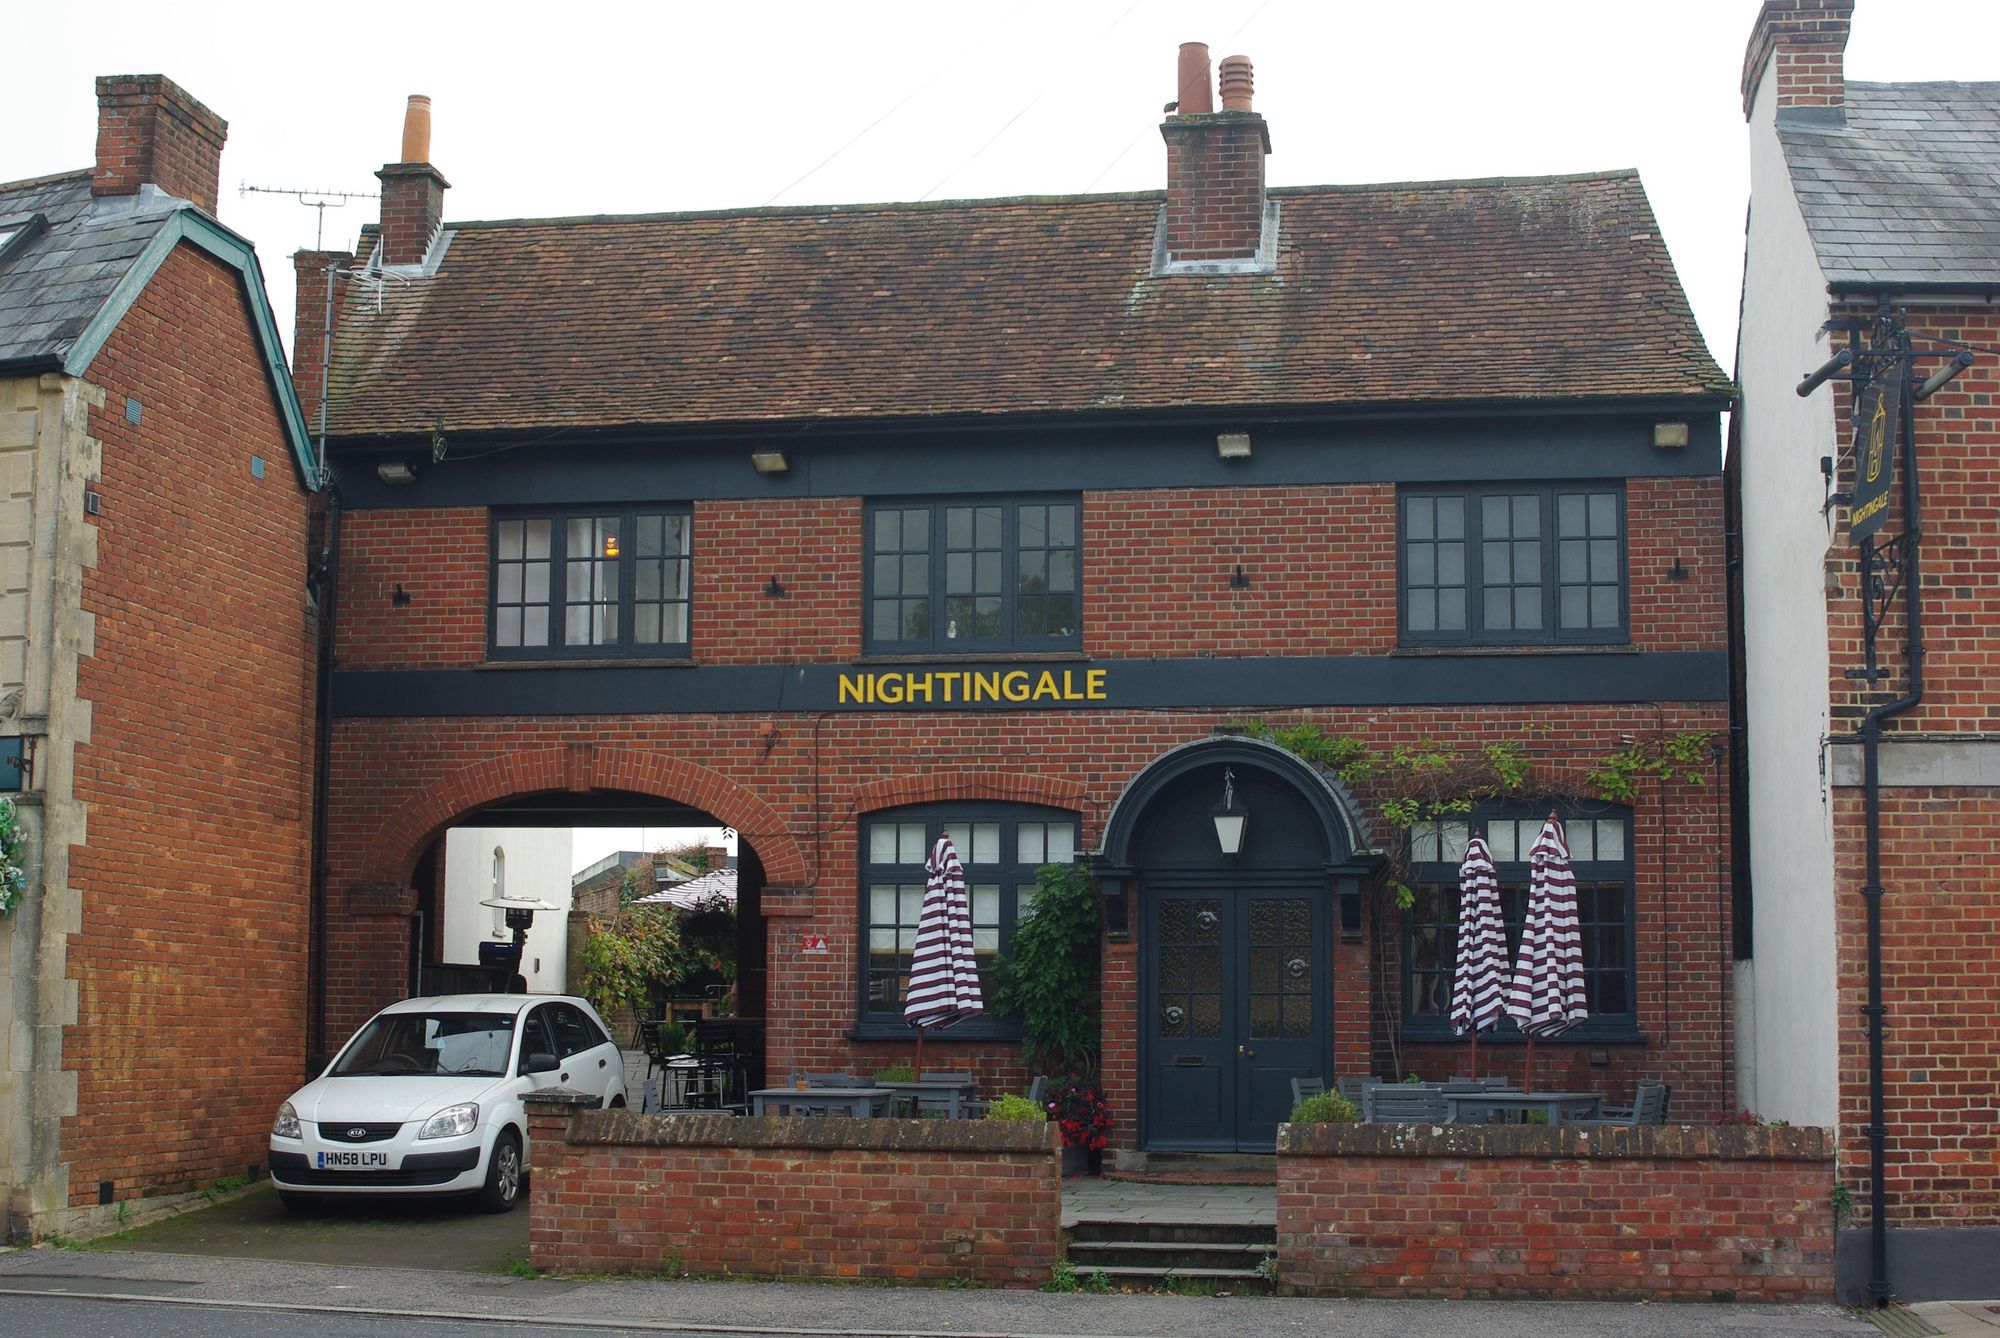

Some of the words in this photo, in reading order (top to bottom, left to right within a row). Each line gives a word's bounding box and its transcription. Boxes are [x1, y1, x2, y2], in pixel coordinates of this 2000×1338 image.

[1851, 490, 1888, 528] NIGHTINGALE
[837, 669, 1107, 704] NIGHTINGALE
[325, 1152, 359, 1166] HN58
[362, 1152, 387, 1166] LPU
